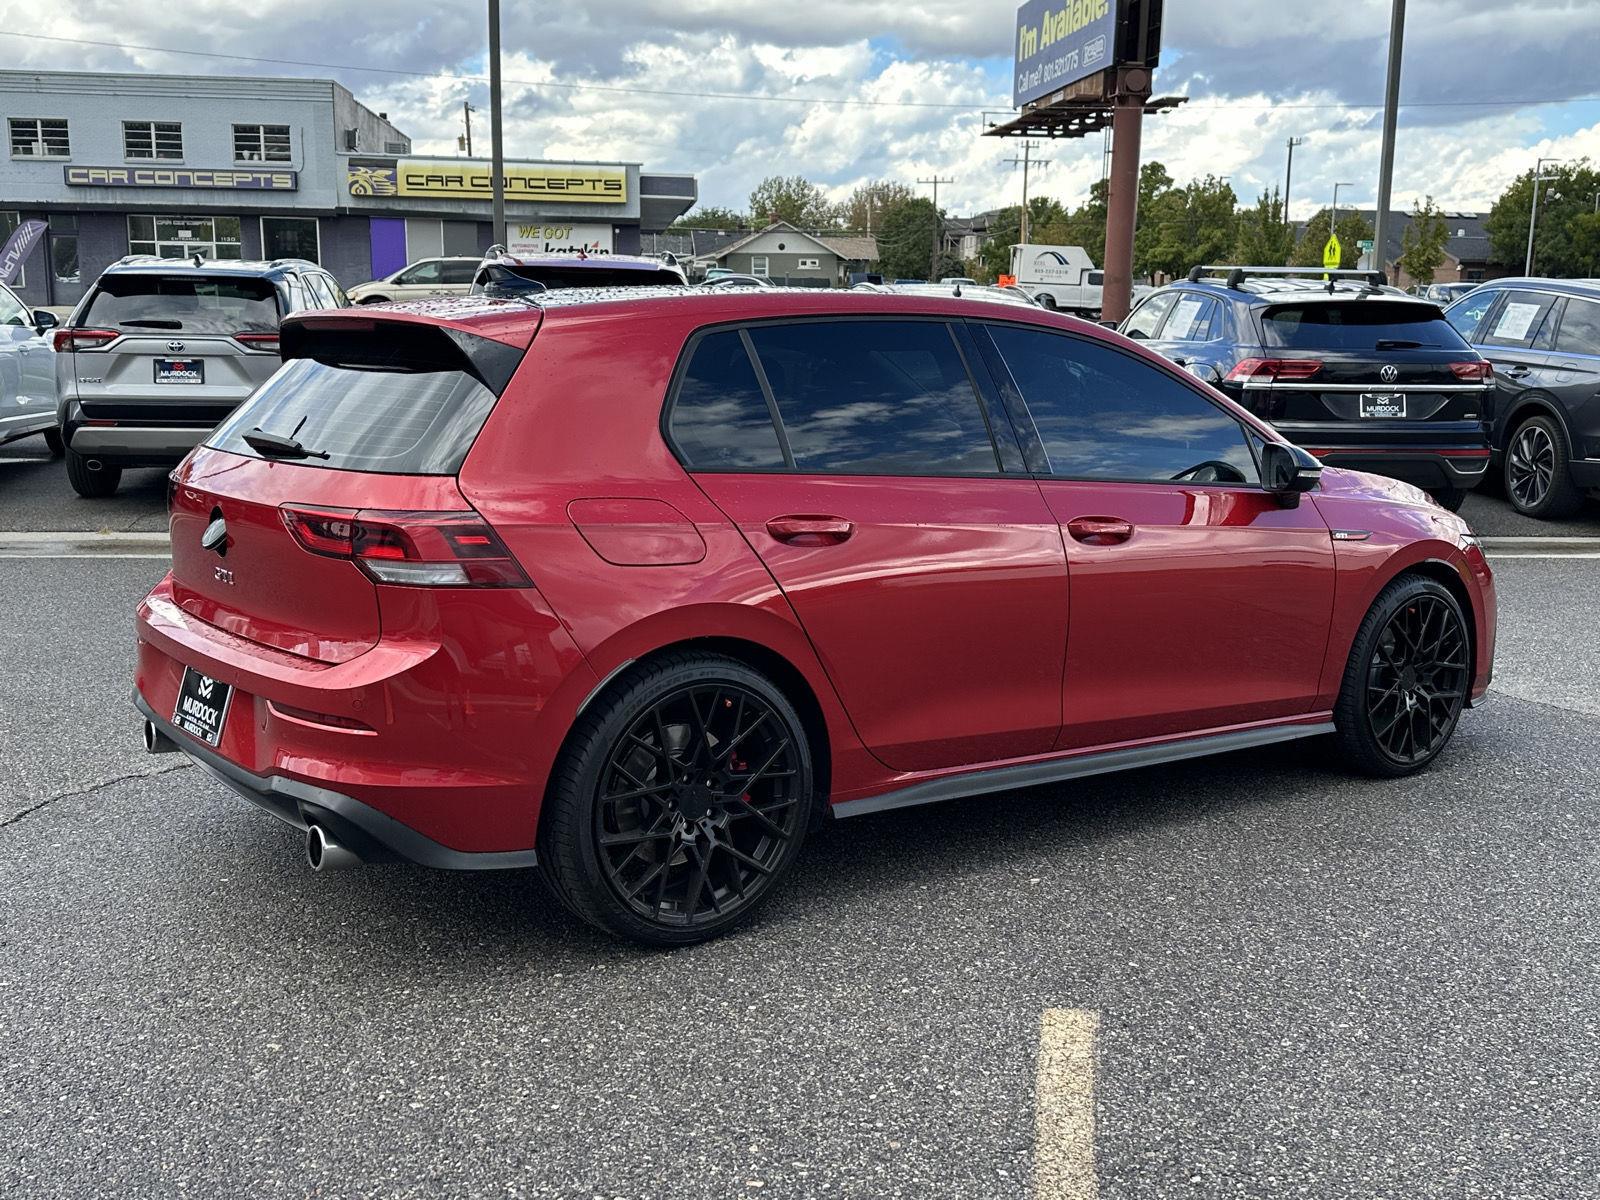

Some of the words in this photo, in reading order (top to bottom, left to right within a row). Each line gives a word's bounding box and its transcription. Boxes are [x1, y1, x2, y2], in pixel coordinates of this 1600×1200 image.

[1019, 24, 1038, 63] I'm
[1018, 69, 1030, 94] Call
[1029, 62, 1043, 88] me?
[68, 168, 128, 184] CAR
[135, 170, 292, 188] CONCEPTS
[406, 174, 464, 188] CAR
[518, 224, 540, 239] WE
[544, 225, 573, 240] GOT
[182, 695, 218, 726] MURDOCK
[184, 720, 203, 738] MURDOCK
